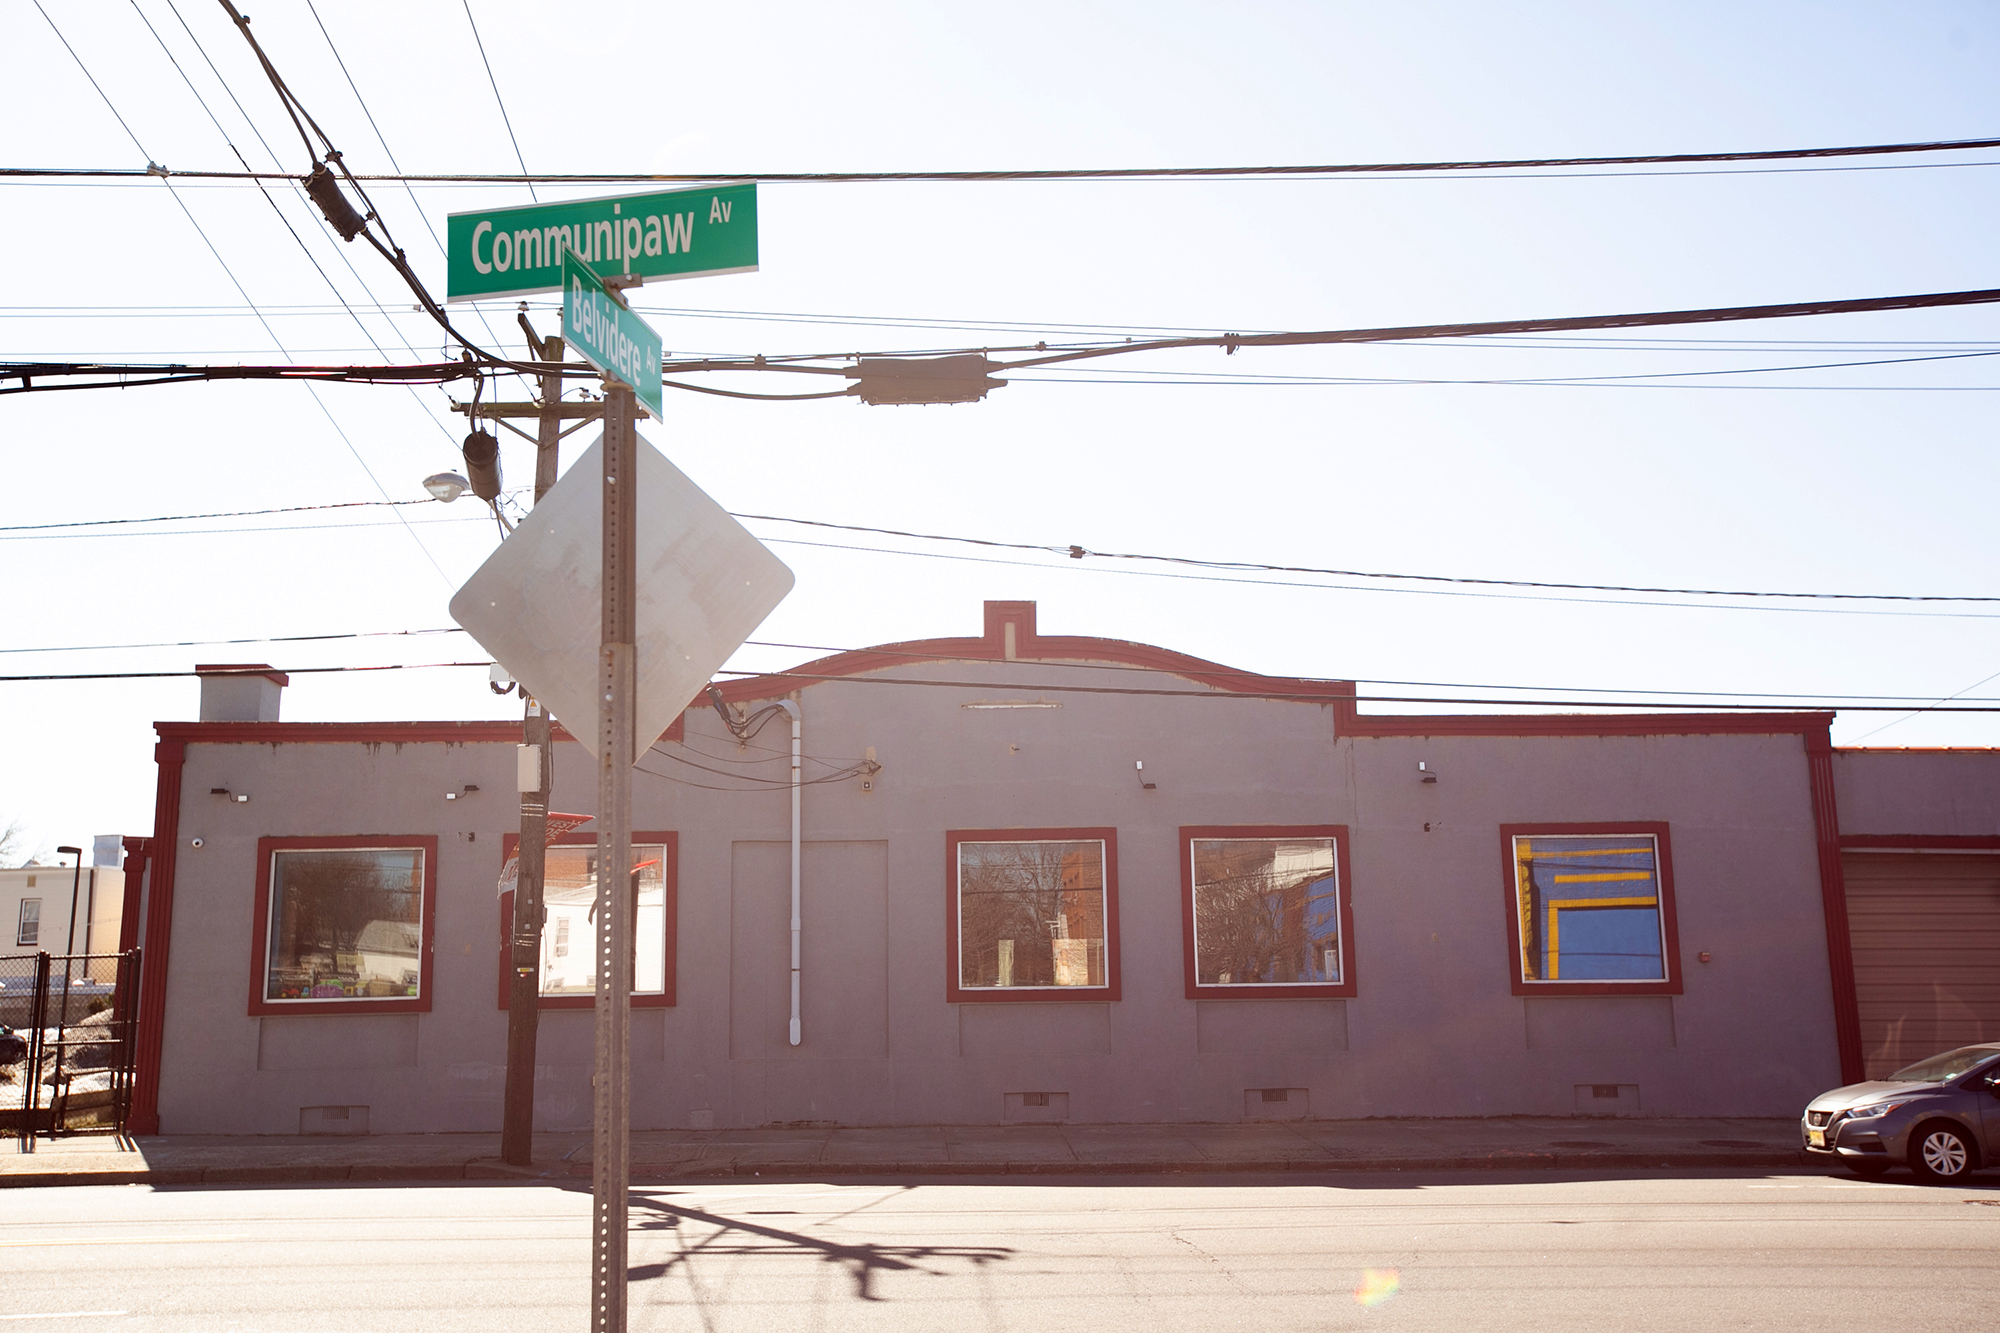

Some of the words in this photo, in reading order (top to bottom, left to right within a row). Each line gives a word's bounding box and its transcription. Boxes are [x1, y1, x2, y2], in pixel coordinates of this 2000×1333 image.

[471, 203, 695, 274] Communipaw
[709, 196, 732, 224] Av
[572, 273, 641, 387] Belvidere
[646, 345, 656, 375] Av
